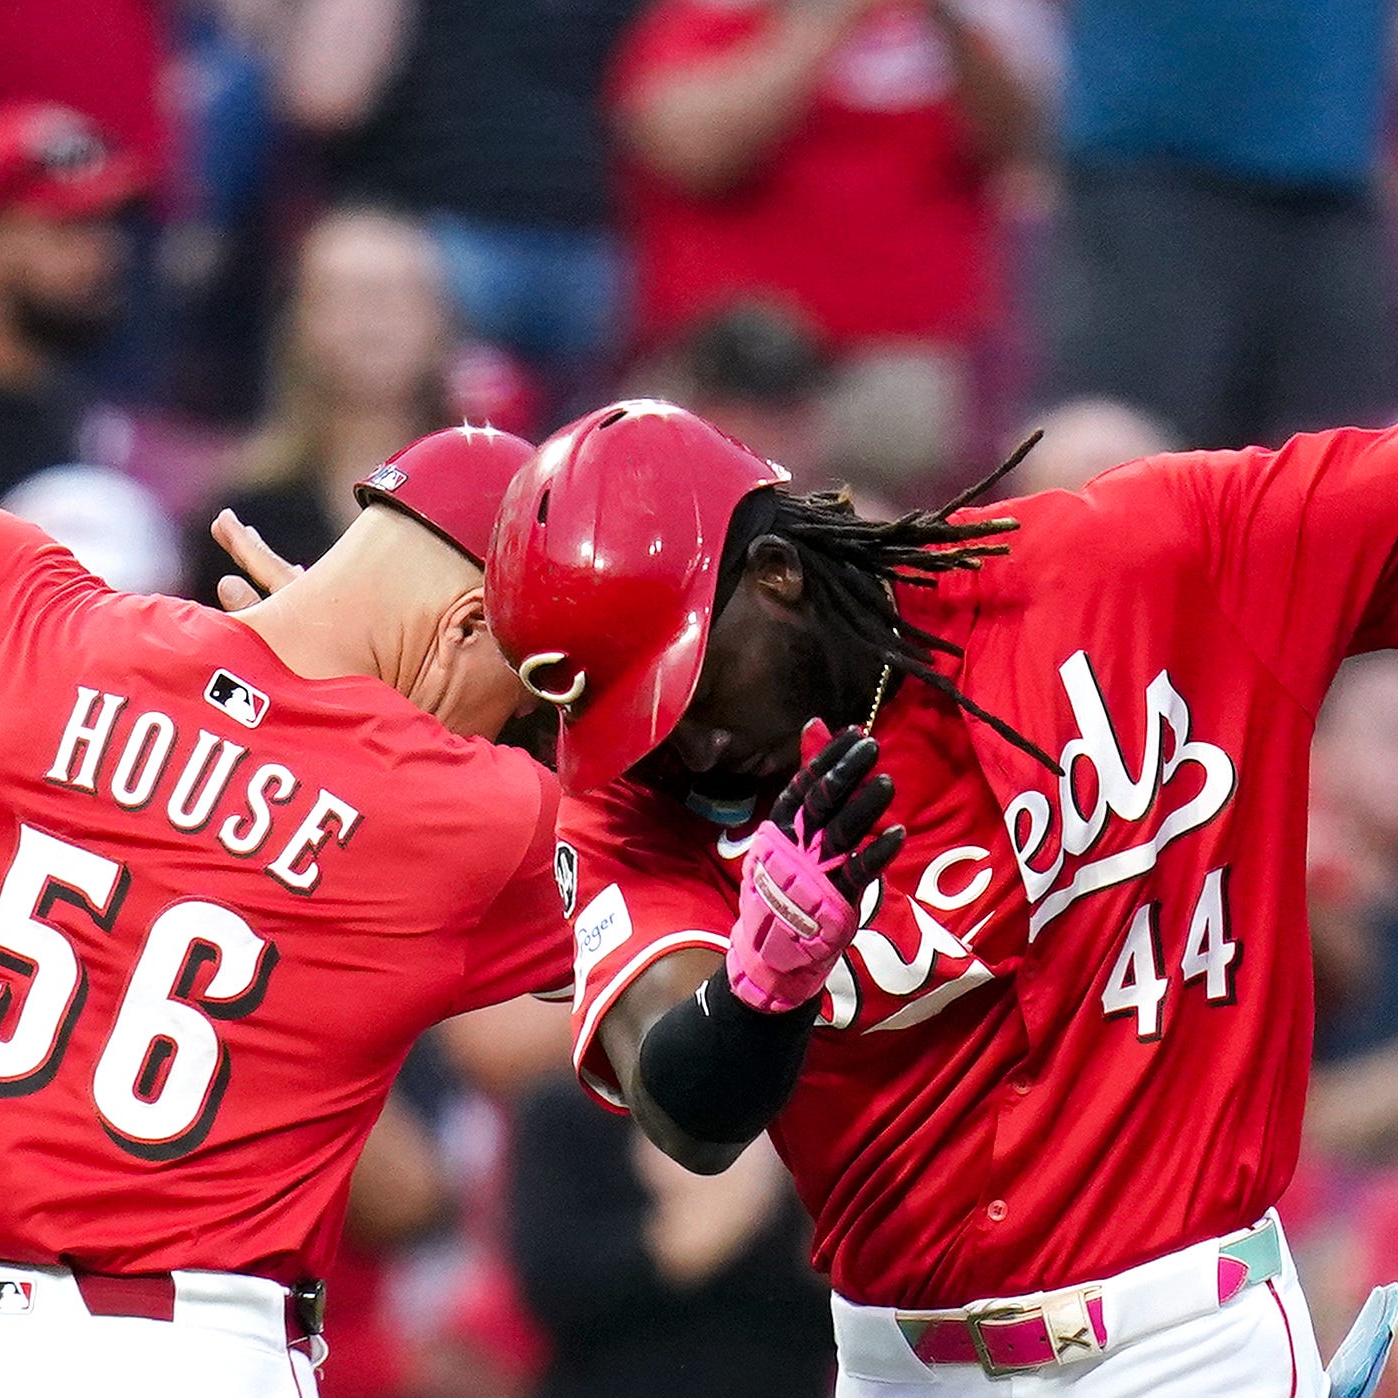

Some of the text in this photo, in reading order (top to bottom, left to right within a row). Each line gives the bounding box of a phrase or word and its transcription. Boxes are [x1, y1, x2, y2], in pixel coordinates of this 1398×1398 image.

[518, 651, 587, 704] C
[44, 685, 365, 896] HOUSE
[576, 912, 616, 956] oger
[1101, 863, 1238, 1043] 44
